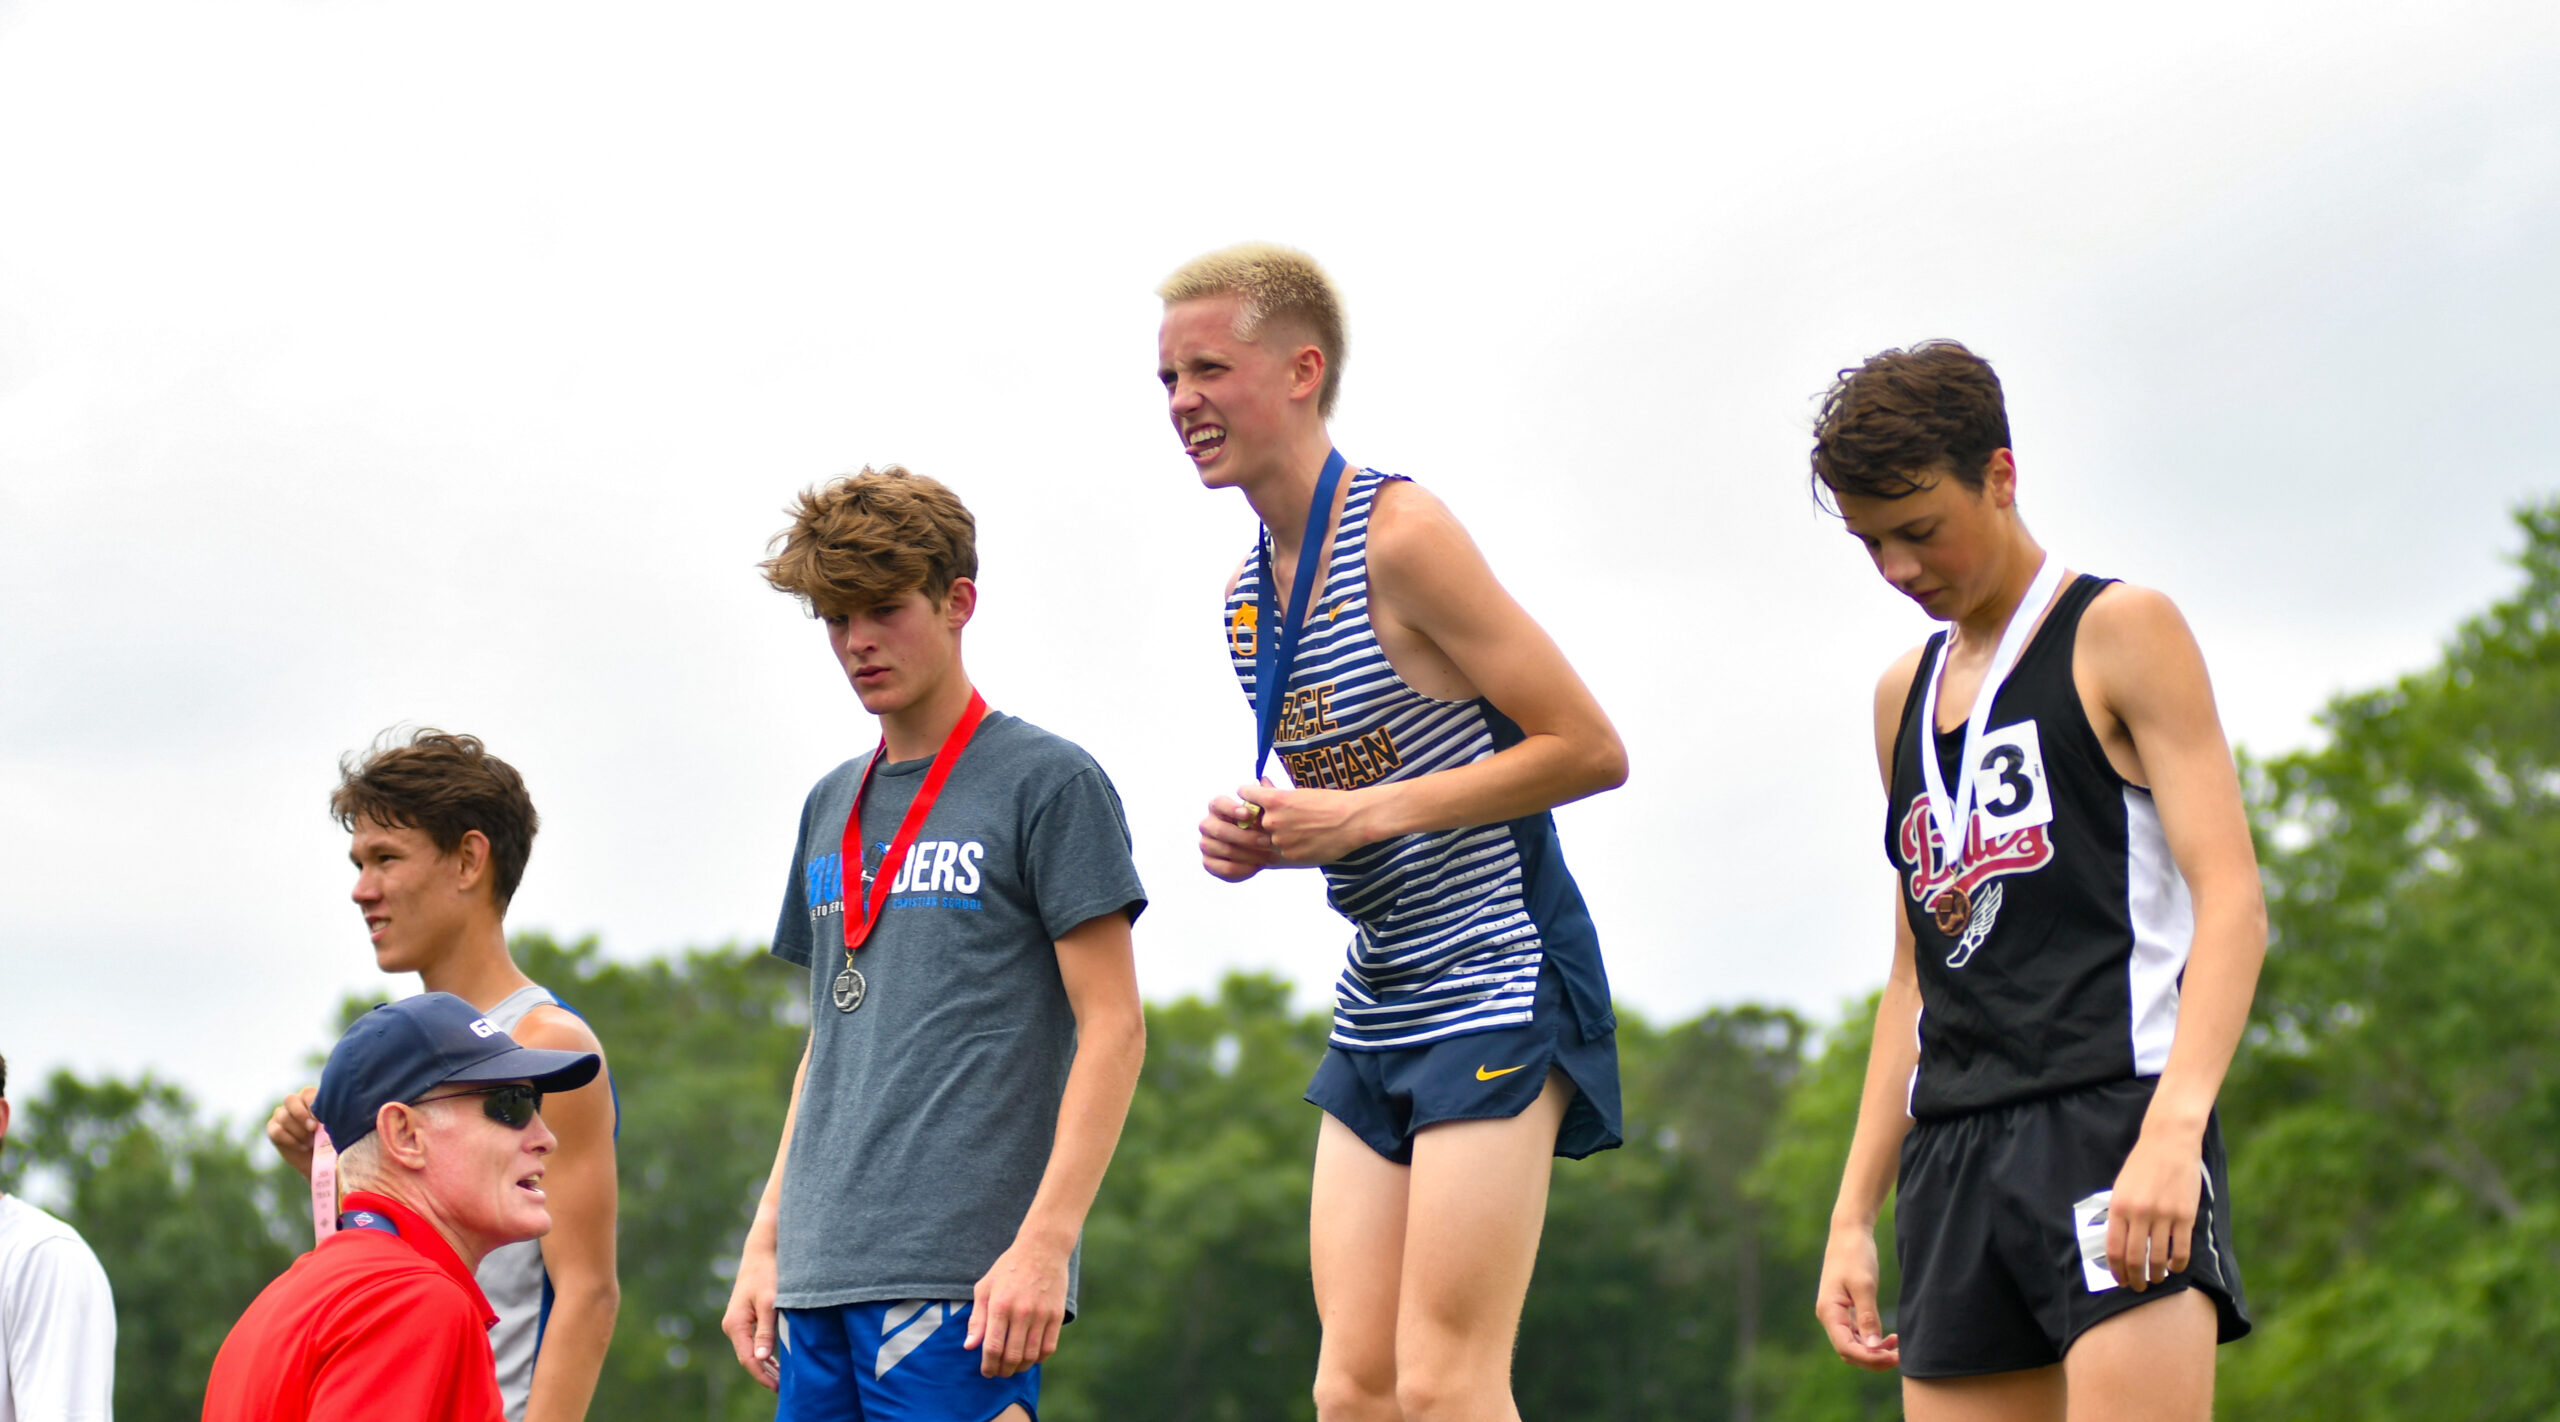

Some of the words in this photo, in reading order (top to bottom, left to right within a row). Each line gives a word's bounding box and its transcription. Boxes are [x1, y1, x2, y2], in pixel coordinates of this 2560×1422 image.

[1274, 682, 1338, 743] RACE
[1980, 743, 2034, 818] 3
[892, 896, 938, 910] CHRISTIAN
[941, 896, 984, 911] SCHOOL
